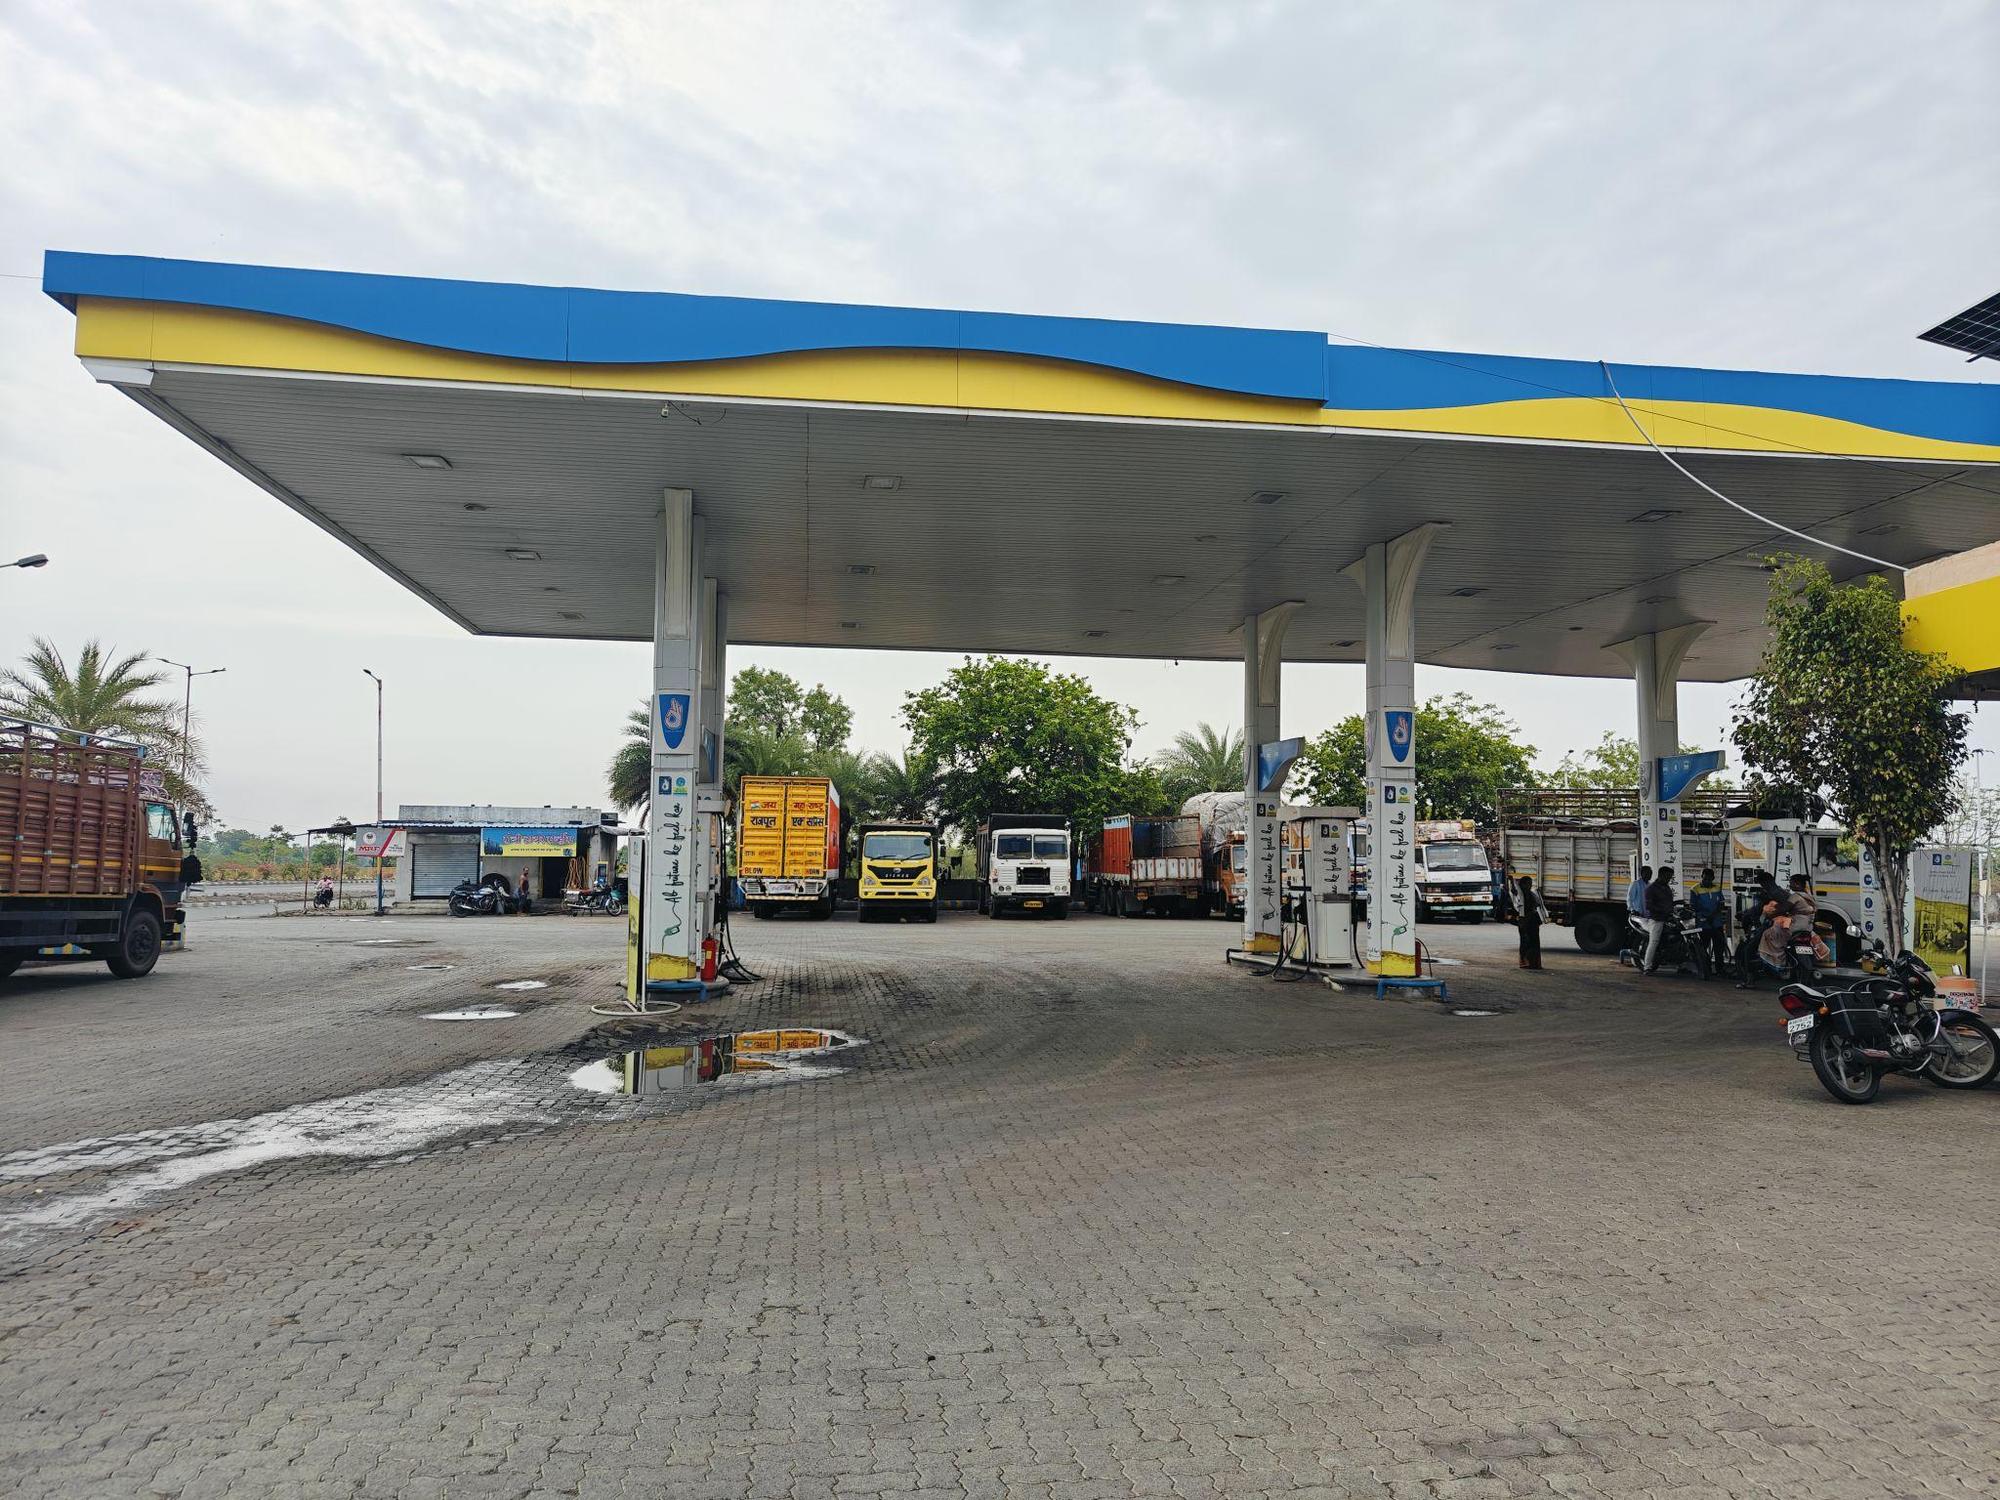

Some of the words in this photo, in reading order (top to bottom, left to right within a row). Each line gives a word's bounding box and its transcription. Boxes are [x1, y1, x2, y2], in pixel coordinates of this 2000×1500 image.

[663, 822, 685, 840] feel
[1389, 828, 1409, 846] feel
[664, 845, 682, 855] ko
[665, 859, 684, 886] future
[1392, 863, 1409, 888] future
